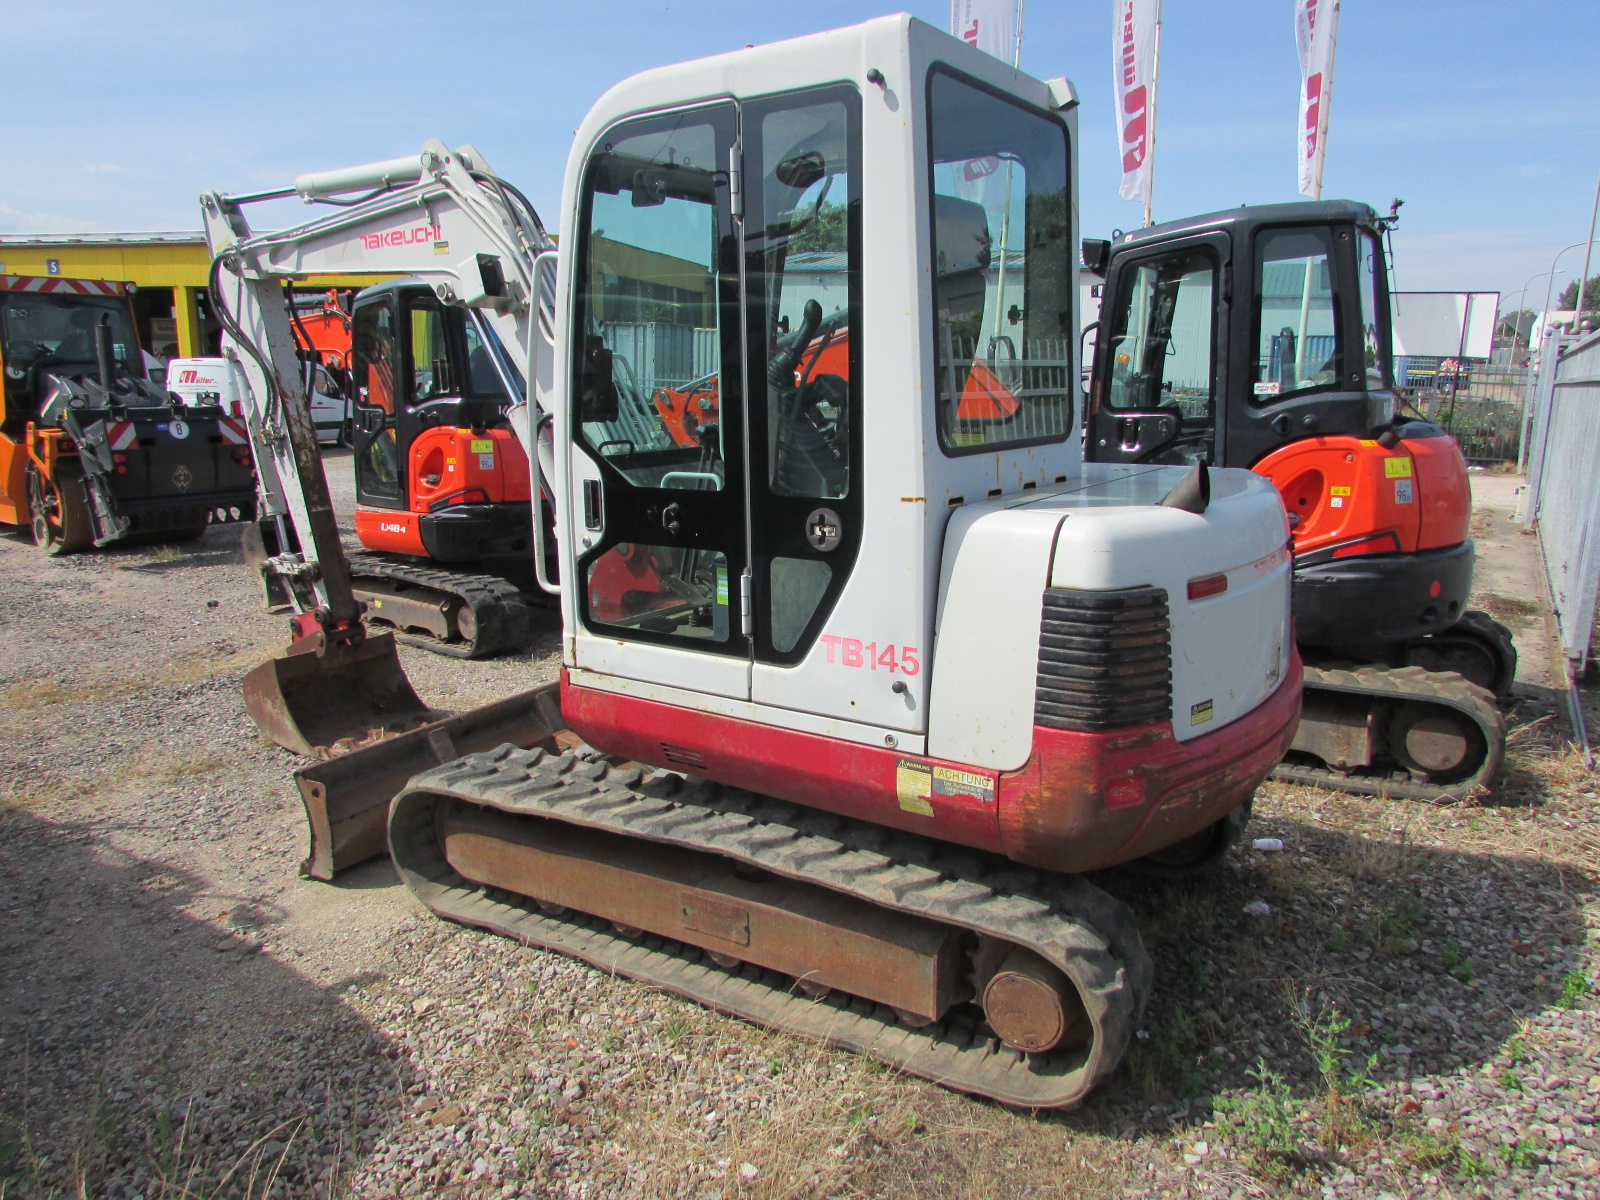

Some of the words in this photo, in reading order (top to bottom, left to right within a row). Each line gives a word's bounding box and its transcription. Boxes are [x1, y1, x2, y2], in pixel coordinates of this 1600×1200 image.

[359, 224, 442, 250] TAKEUCHI
[51, 262, 58, 273] 5
[176, 423, 183, 436] 8
[820, 634, 920, 677] TB145
[905, 760, 931, 772] WARNUNG
[939, 768, 989, 788] ACHTUNG
